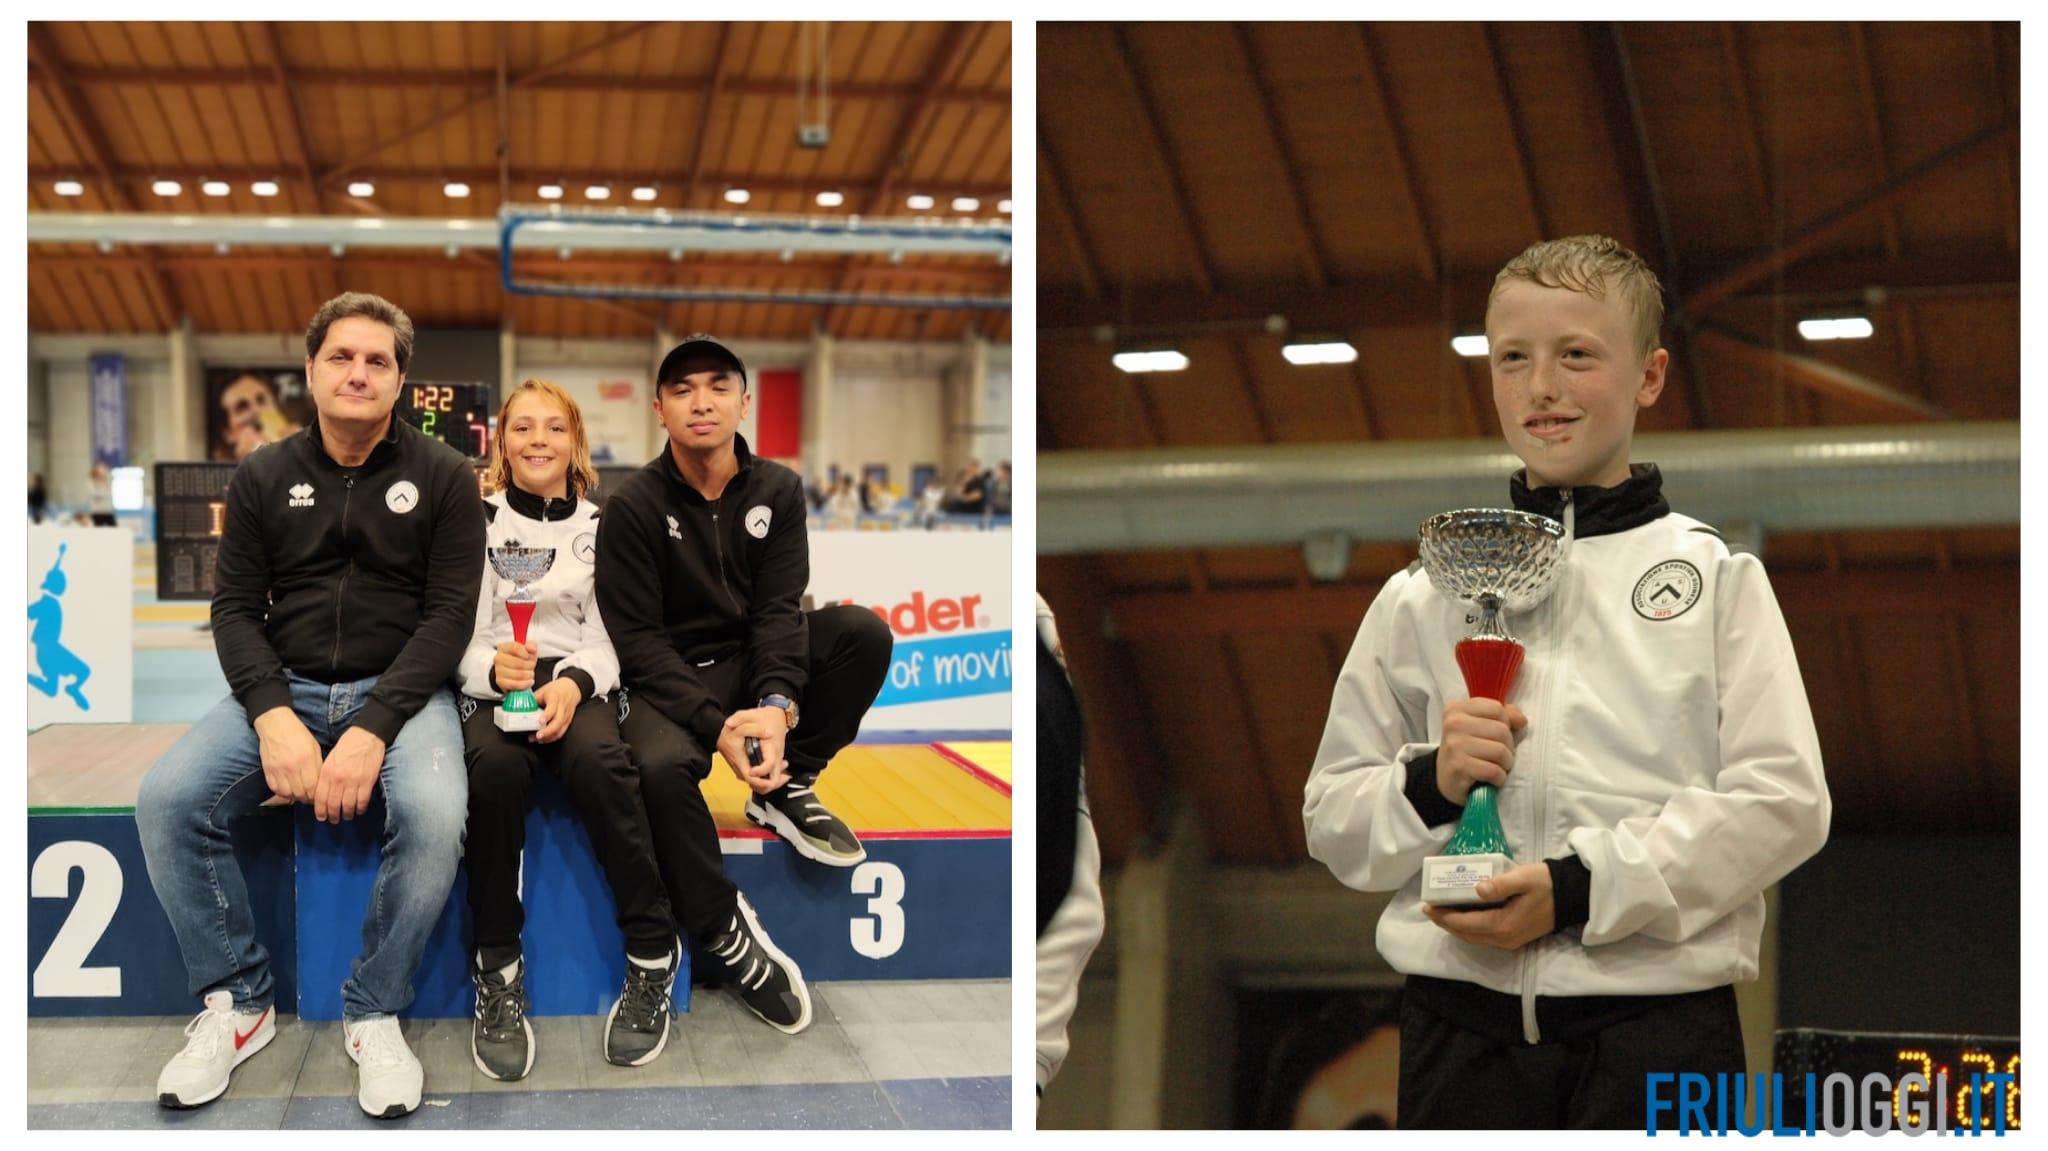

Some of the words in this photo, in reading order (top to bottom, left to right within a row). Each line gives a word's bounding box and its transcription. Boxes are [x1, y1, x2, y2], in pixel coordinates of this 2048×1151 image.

[413, 386, 453, 411] 1:22
[422, 411, 436, 436] 2
[469, 424, 486, 456] 7
[890, 651, 924, 689] of
[933, 642, 1011, 686] movi
[31, 840, 123, 997] 2
[850, 861, 905, 959] 3
